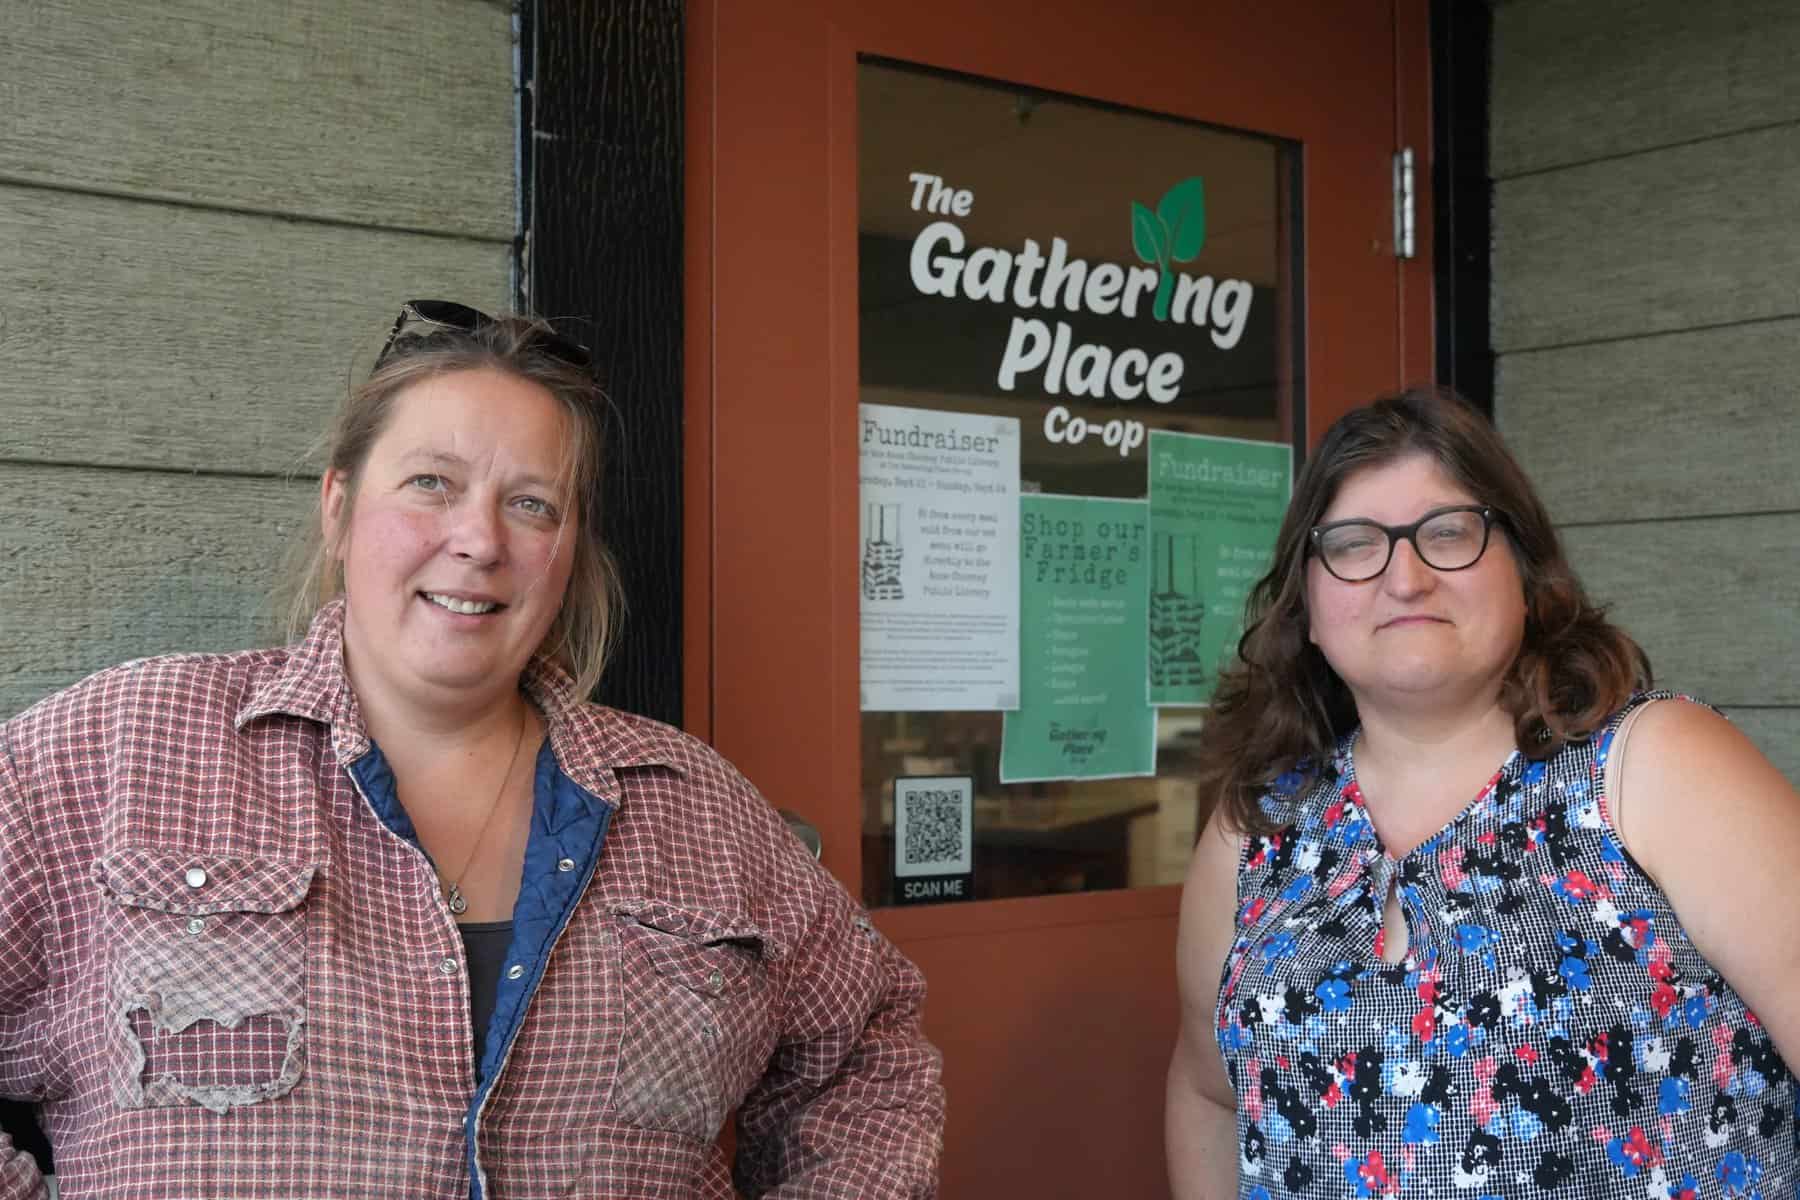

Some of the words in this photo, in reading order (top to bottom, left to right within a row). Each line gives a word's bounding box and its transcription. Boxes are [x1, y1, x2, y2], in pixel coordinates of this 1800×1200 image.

[909, 172, 974, 217] The
[910, 221, 1253, 350] Gathering
[998, 316, 1184, 403] Place
[863, 419, 999, 453] Fundraiser
[1044, 406, 1144, 457] Co-op
[1159, 452, 1283, 489] Fundraiser
[1024, 513, 1083, 543] Shop
[1097, 521, 1145, 539] our
[1024, 536, 1140, 562] Farmer's
[1036, 560, 1128, 591] Fridge
[904, 881, 940, 899] SCAN
[943, 879, 964, 897] ME
